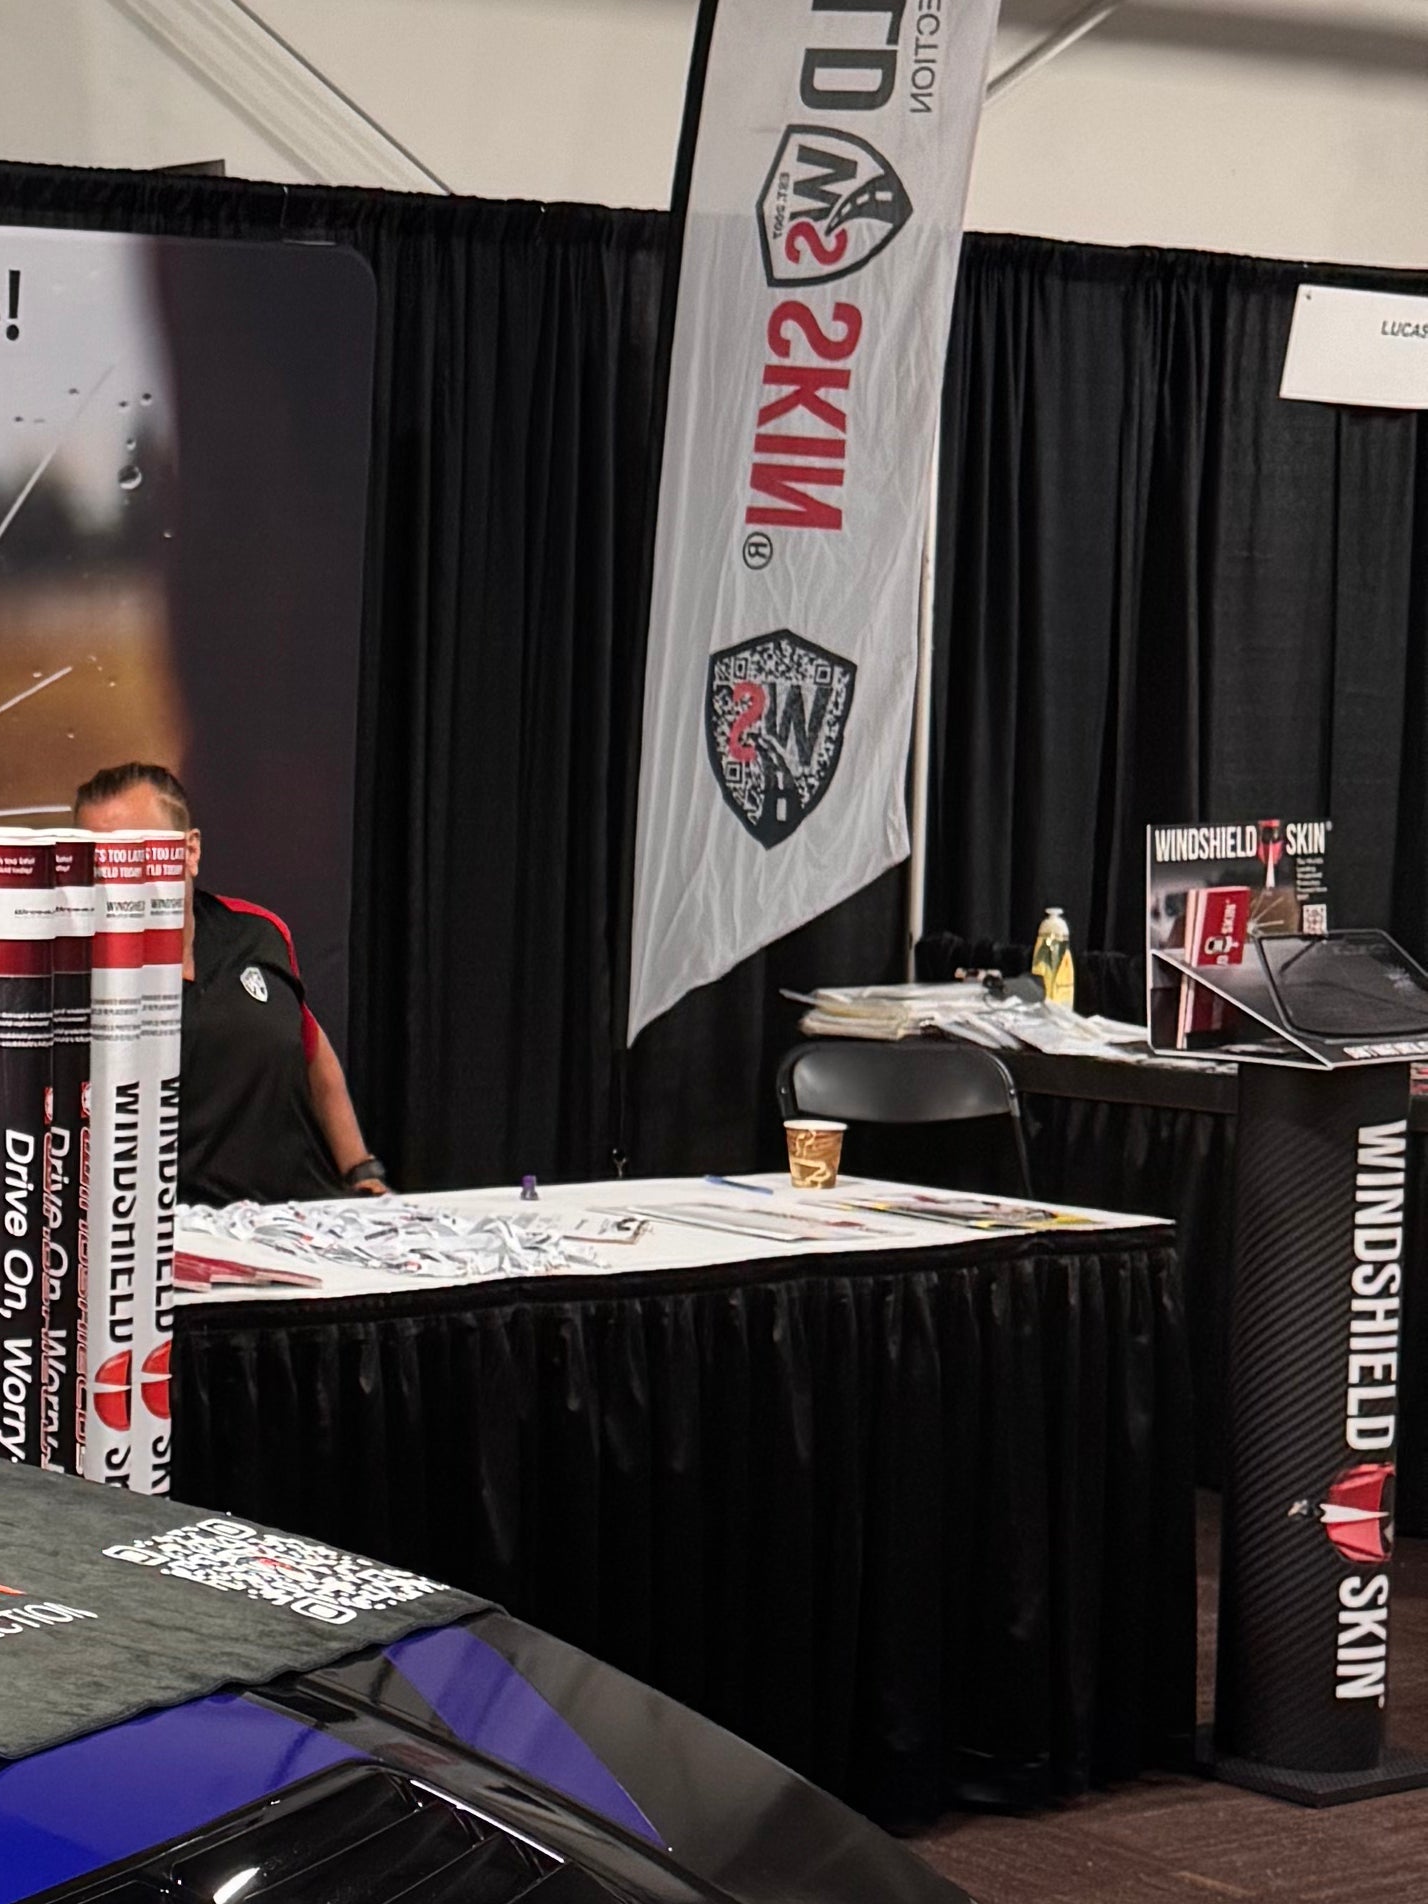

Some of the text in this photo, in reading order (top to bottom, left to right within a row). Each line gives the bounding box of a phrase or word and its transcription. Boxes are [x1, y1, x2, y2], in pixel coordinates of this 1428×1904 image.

[1154, 825, 1258, 863] WINDSHIELD
[4, 1128, 35, 1238] Drive
[1344, 1119, 1407, 1451] WINDSHIELD
